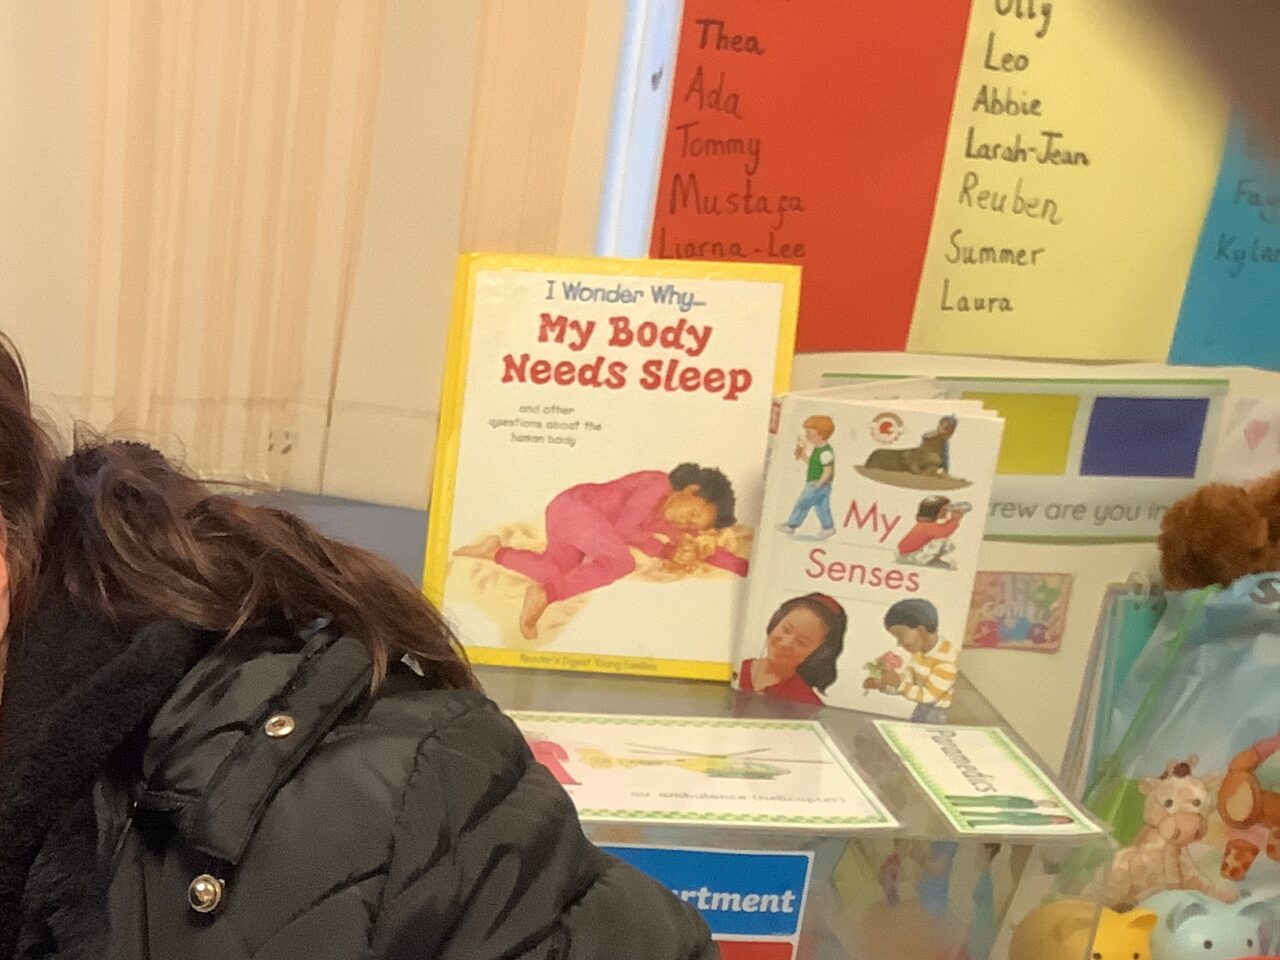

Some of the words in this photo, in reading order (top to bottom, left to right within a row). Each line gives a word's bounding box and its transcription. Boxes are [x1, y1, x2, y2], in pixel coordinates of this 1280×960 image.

[695, 19, 765, 55] Thea
[984, 31, 1029, 72] Leo
[684, 66, 742, 119] Ada
[972, 84, 1042, 116] Abbie
[676, 121, 761, 176] Tommy
[669, 172, 805, 231] Mustafa
[958, 171, 1063, 225] Reuben
[944, 228, 1046, 266] Summer
[545, 280, 556, 300] I
[562, 281, 644, 304] Wonder
[940, 278, 1013, 313] Laura
[537, 312, 596, 351] My
[607, 315, 713, 357] Body
[501, 352, 628, 390] Needs
[639, 357, 753, 401] Sleep
[843, 499, 901, 543] My
[990, 501, 1038, 519] rew
[1044, 502, 1088, 521] are
[1093, 503, 1141, 526] you
[805, 548, 920, 592] Senses
[672, 886, 796, 913] rtment
